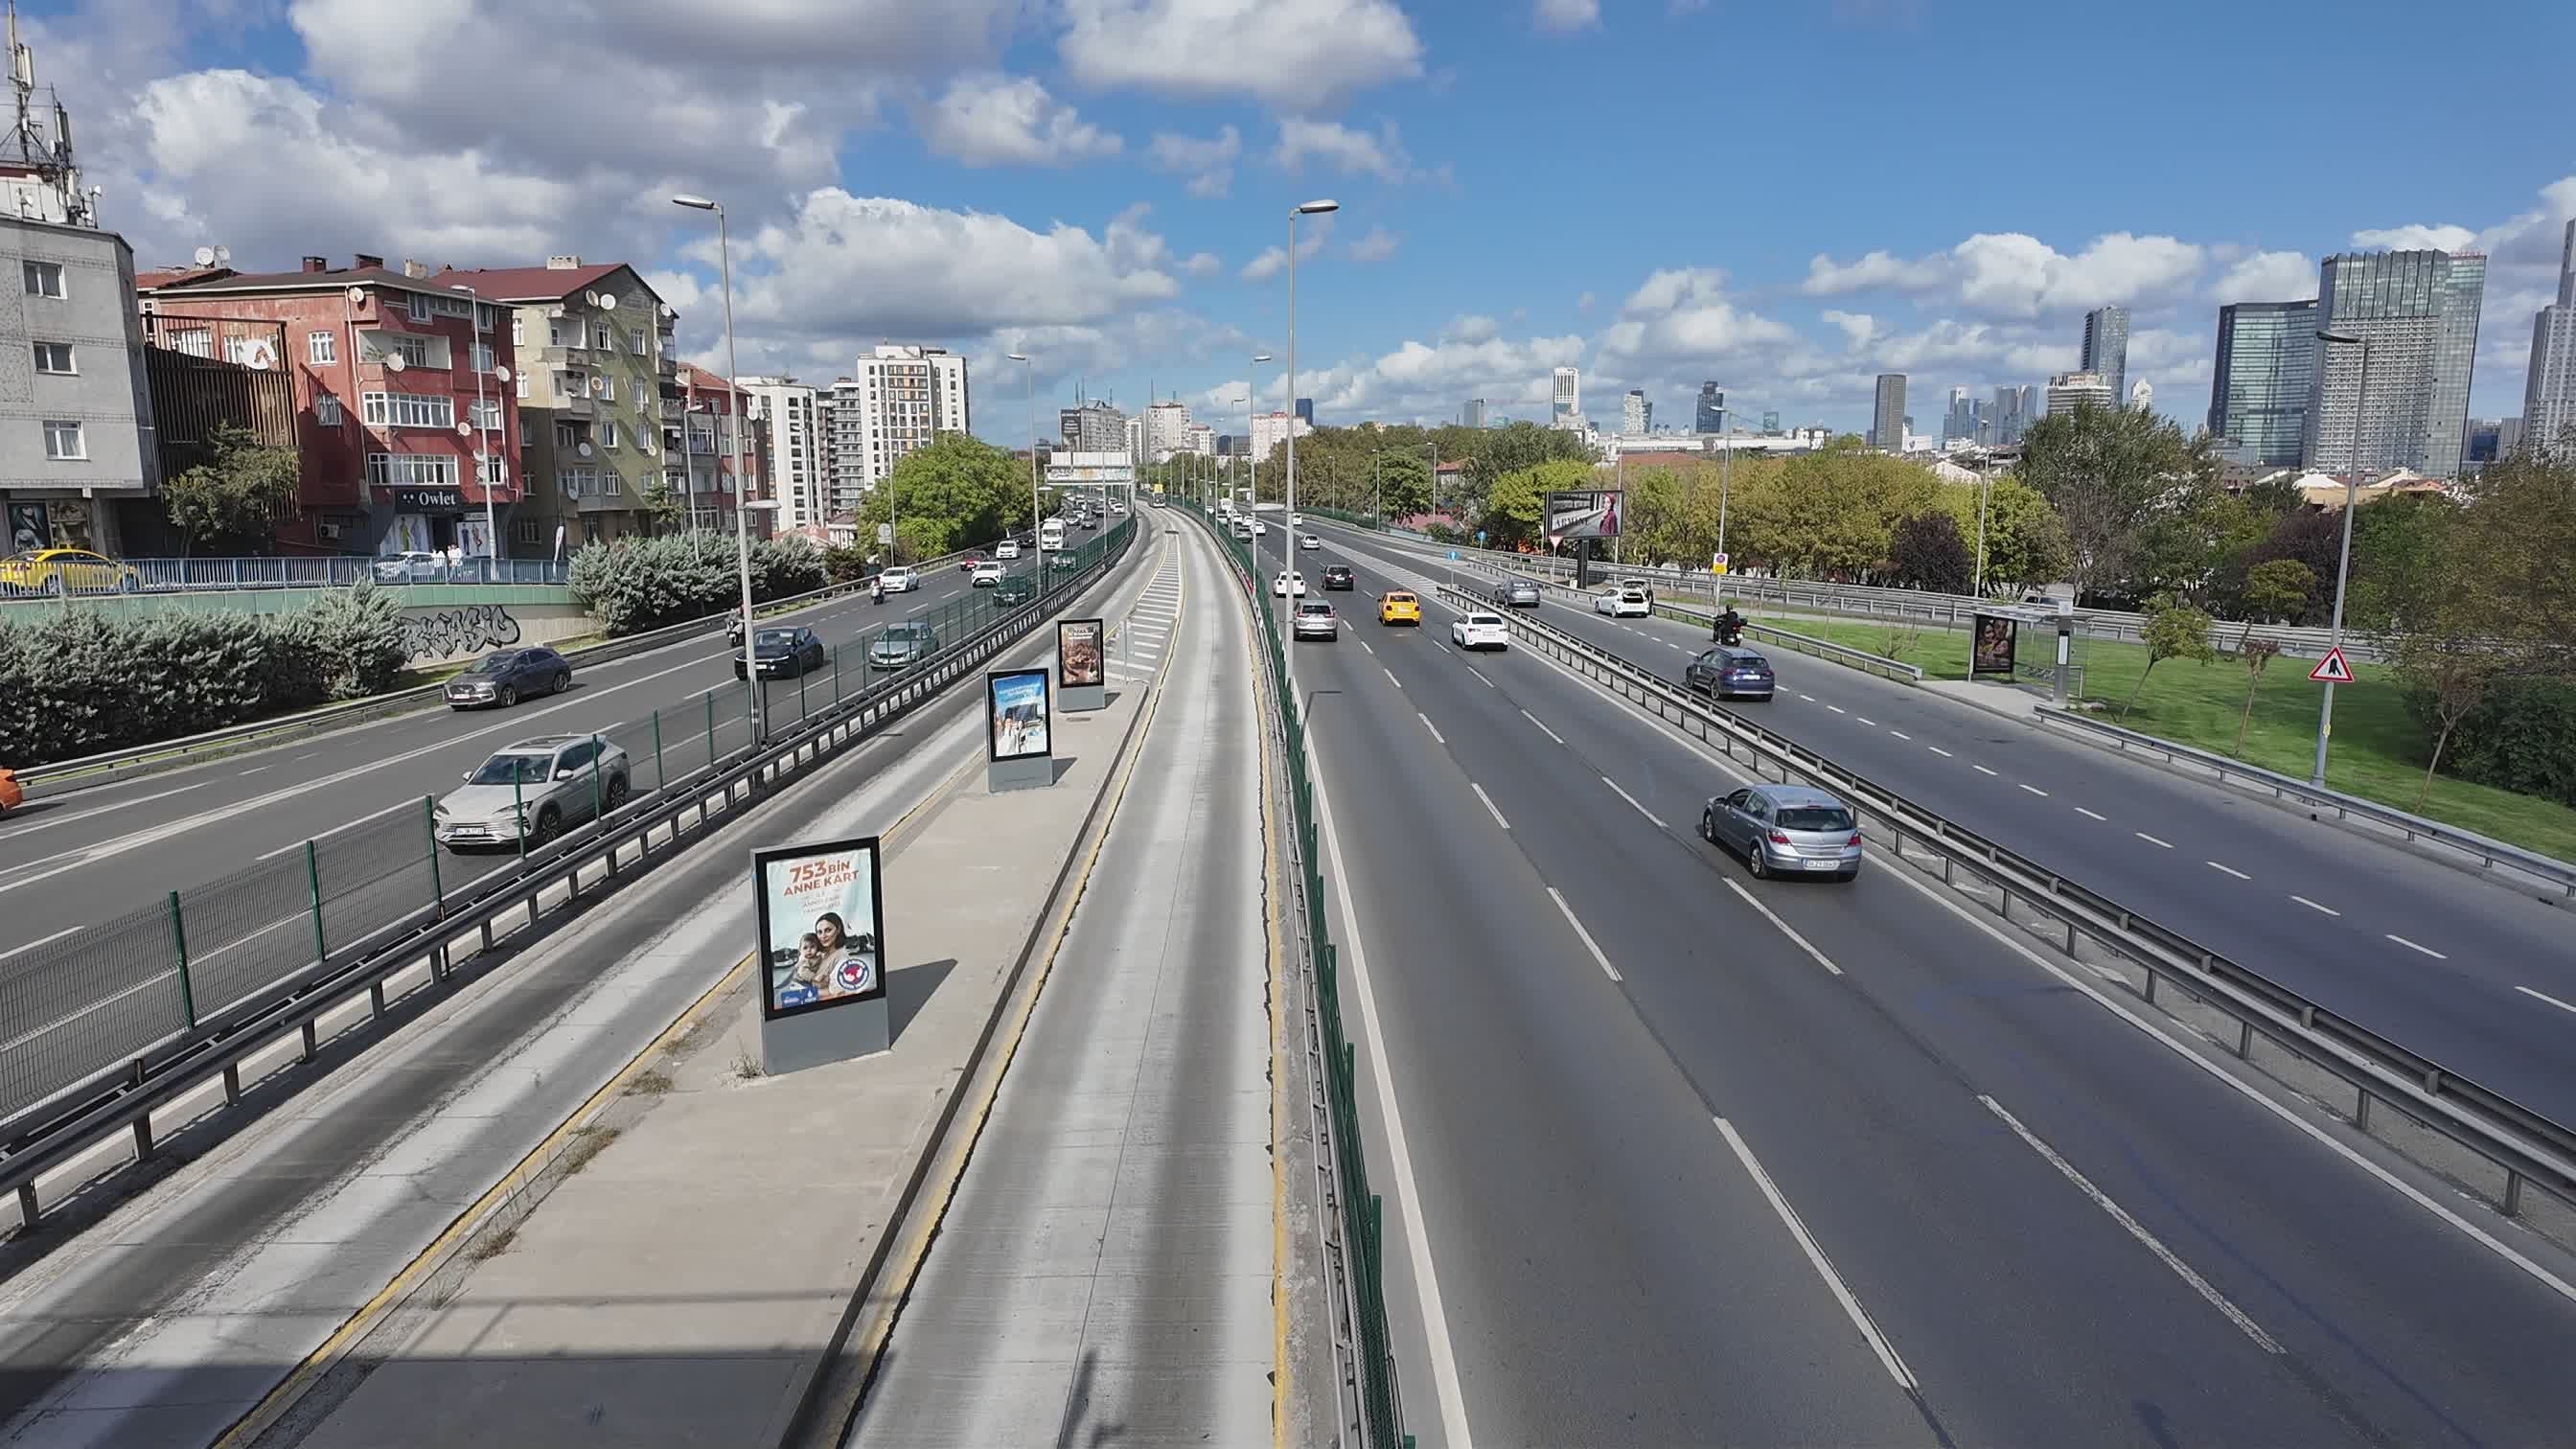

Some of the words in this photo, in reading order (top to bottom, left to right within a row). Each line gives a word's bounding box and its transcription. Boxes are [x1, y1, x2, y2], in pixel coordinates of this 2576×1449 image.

[419, 492, 455, 505] Owlet
[784, 879, 821, 896] ANNE
[824, 870, 859, 886] KART
[790, 860, 826, 883] 753
[829, 860, 850, 874] BİN
